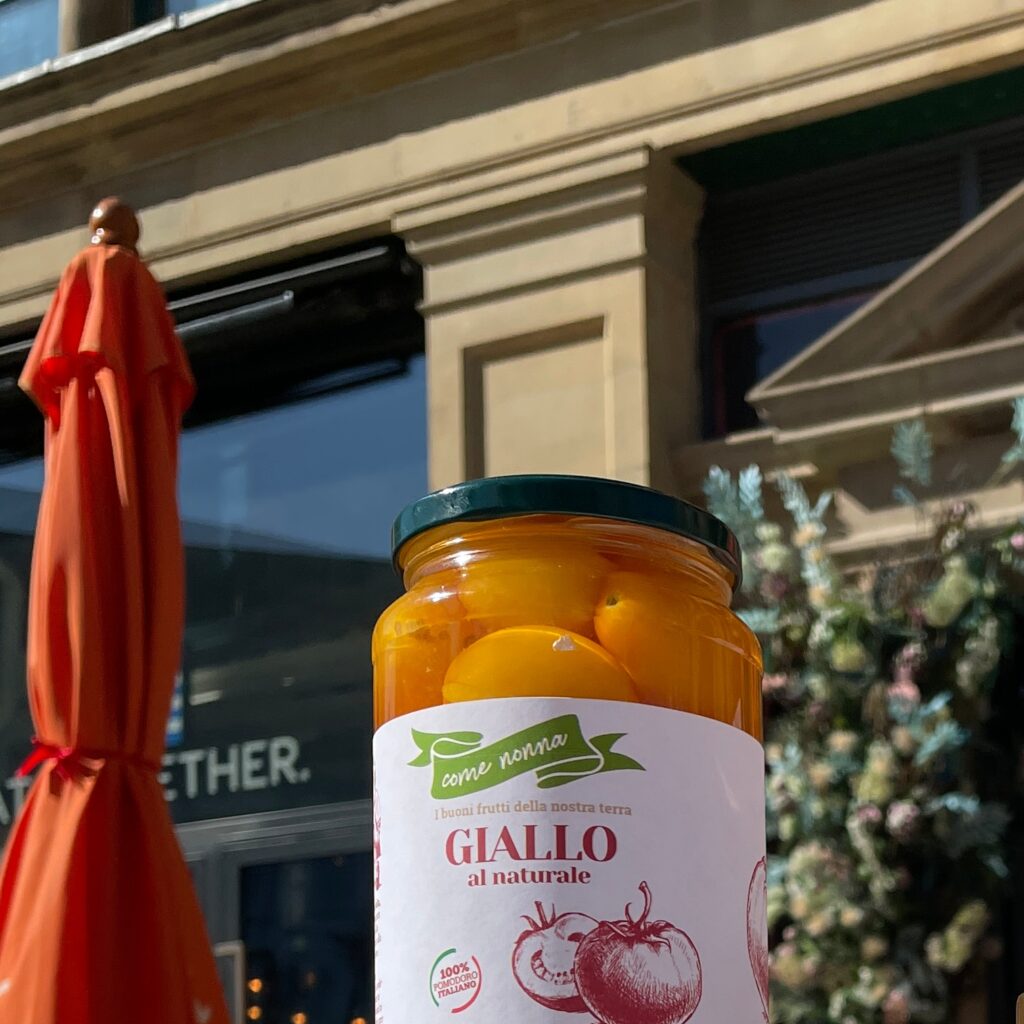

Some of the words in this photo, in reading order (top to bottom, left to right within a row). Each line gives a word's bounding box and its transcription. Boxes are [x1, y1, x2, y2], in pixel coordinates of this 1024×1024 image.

[157, 735, 312, 801] ETHER.
[441, 762, 492, 788] come
[500, 733, 568, 769] nonna
[434, 808, 439, 820] I
[441, 803, 474, 818] buoni
[477, 801, 510, 816] frutti
[514, 800, 547, 813] della
[551, 802, 595, 814] nostra
[599, 803, 632, 816] terra
[445, 825, 618, 866] GIALLO
[467, 869, 487, 887] al
[493, 867, 591, 885] naturale
[440, 962, 470, 979] 100%
[433, 971, 478, 991] POMODORO
[438, 980, 476, 998] ITALIANO
